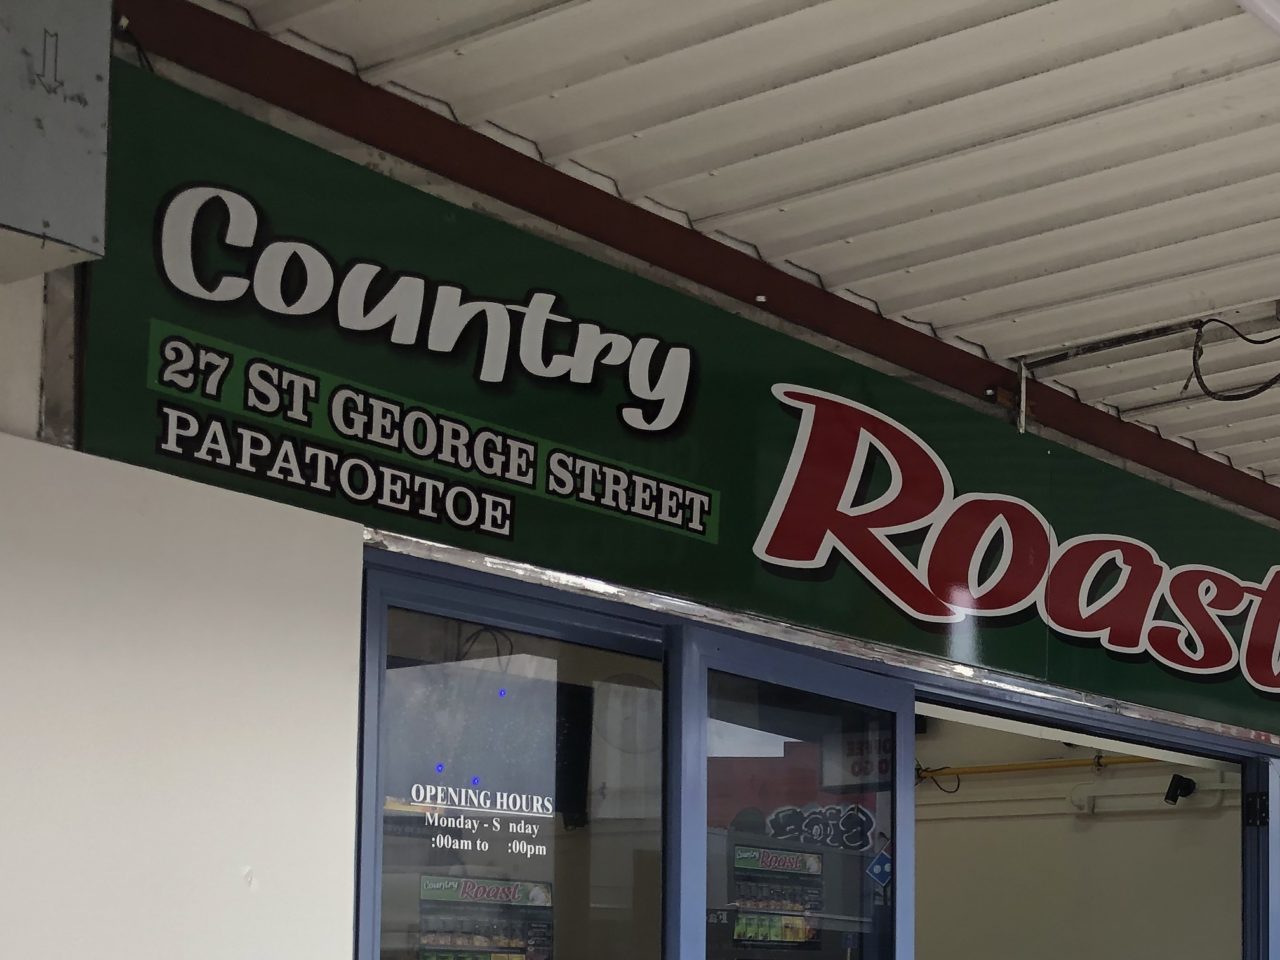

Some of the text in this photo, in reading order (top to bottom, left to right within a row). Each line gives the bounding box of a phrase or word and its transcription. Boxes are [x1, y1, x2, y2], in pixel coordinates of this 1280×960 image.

[159, 185, 692, 433] Country
[160, 339, 712, 533] 27 ST GEORGE STREET
[160, 406, 513, 537] PAPATOETOE
[411, 783, 554, 814] OPENING HOURS
[425, 812, 480, 834] Monday
[476, 837, 489, 851] to
